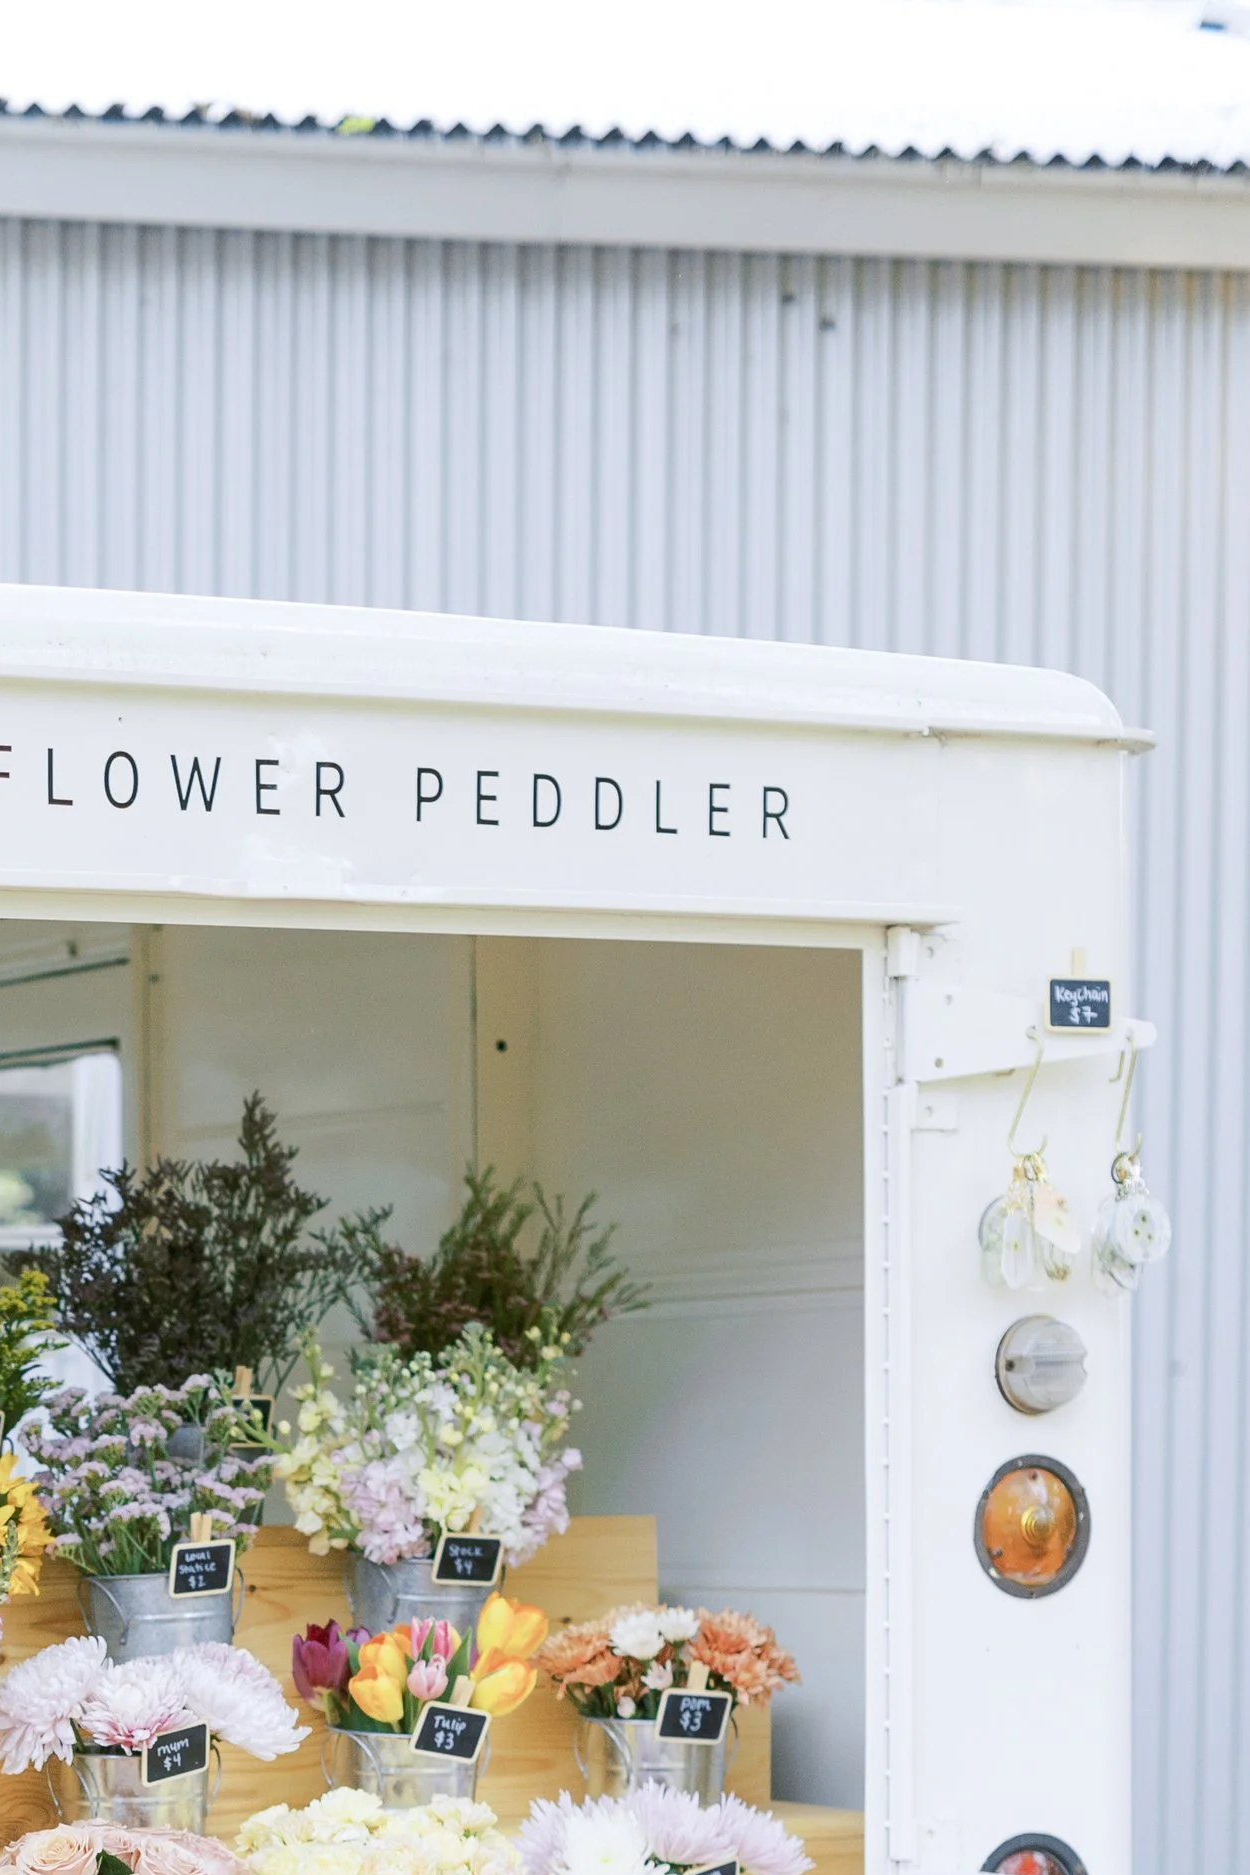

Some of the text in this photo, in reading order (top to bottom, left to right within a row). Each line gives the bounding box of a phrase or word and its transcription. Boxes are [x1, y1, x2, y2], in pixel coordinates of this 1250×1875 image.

[416, 767, 790, 840] PEDDLER
[1054, 985, 1109, 1007] Keychain
[1069, 1006, 1099, 1024] $7
[454, 1558, 473, 1576] $4
[434, 1715, 467, 1736] Tulip
[679, 1709, 702, 1732] $3
[434, 1730, 455, 1750] $3
[163, 1753, 182, 1771] $4
